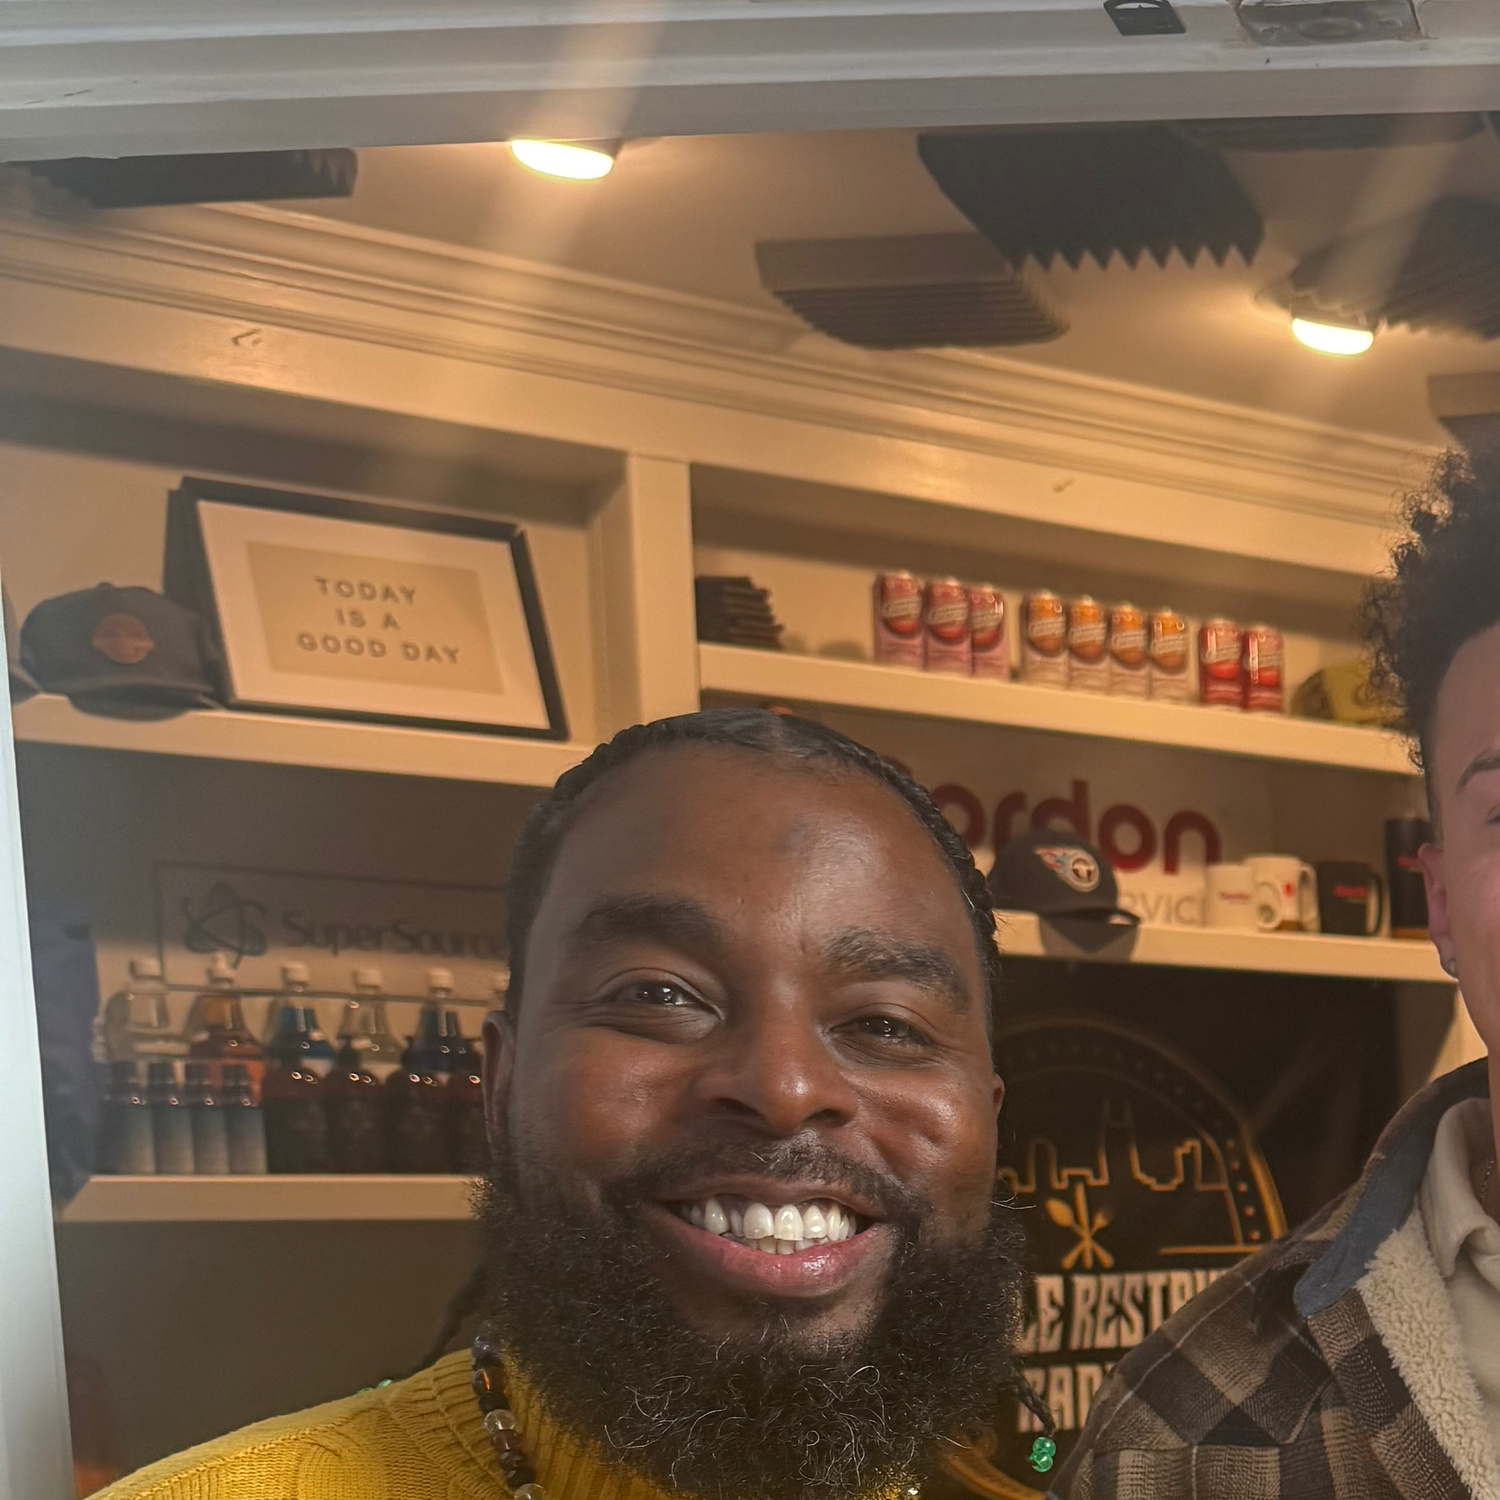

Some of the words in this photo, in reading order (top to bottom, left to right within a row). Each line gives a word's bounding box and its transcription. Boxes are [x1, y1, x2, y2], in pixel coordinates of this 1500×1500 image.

[313, 575, 417, 605] TODAY
[335, 606, 366, 628] IS
[381, 611, 402, 631] A
[296, 630, 387, 658] GOOD
[399, 640, 459, 665] DAY
[884, 756, 1222, 876] ordon
[1018, 1363, 1114, 1433] RAD
